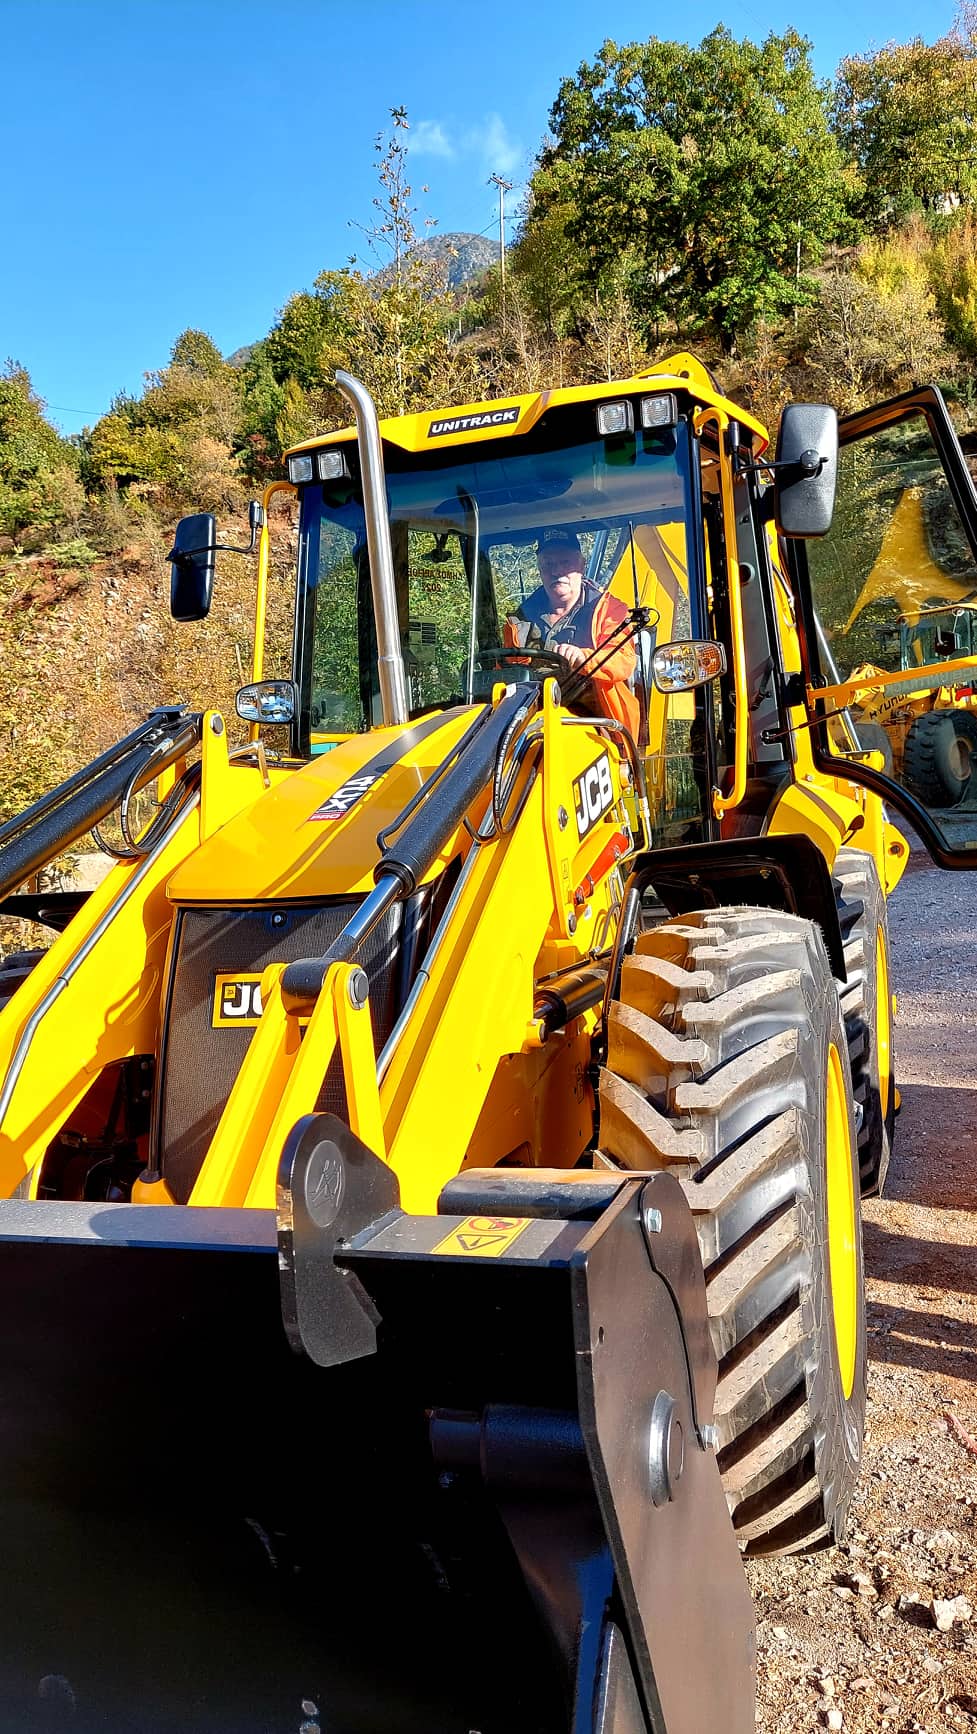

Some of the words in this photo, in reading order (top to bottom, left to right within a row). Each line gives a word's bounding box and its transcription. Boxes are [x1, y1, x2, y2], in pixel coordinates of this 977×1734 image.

[431, 410, 516, 433] UNITRACK
[869, 694, 907, 720] HYUND
[576, 755, 613, 834] JCB
[223, 984, 263, 1016] JC
